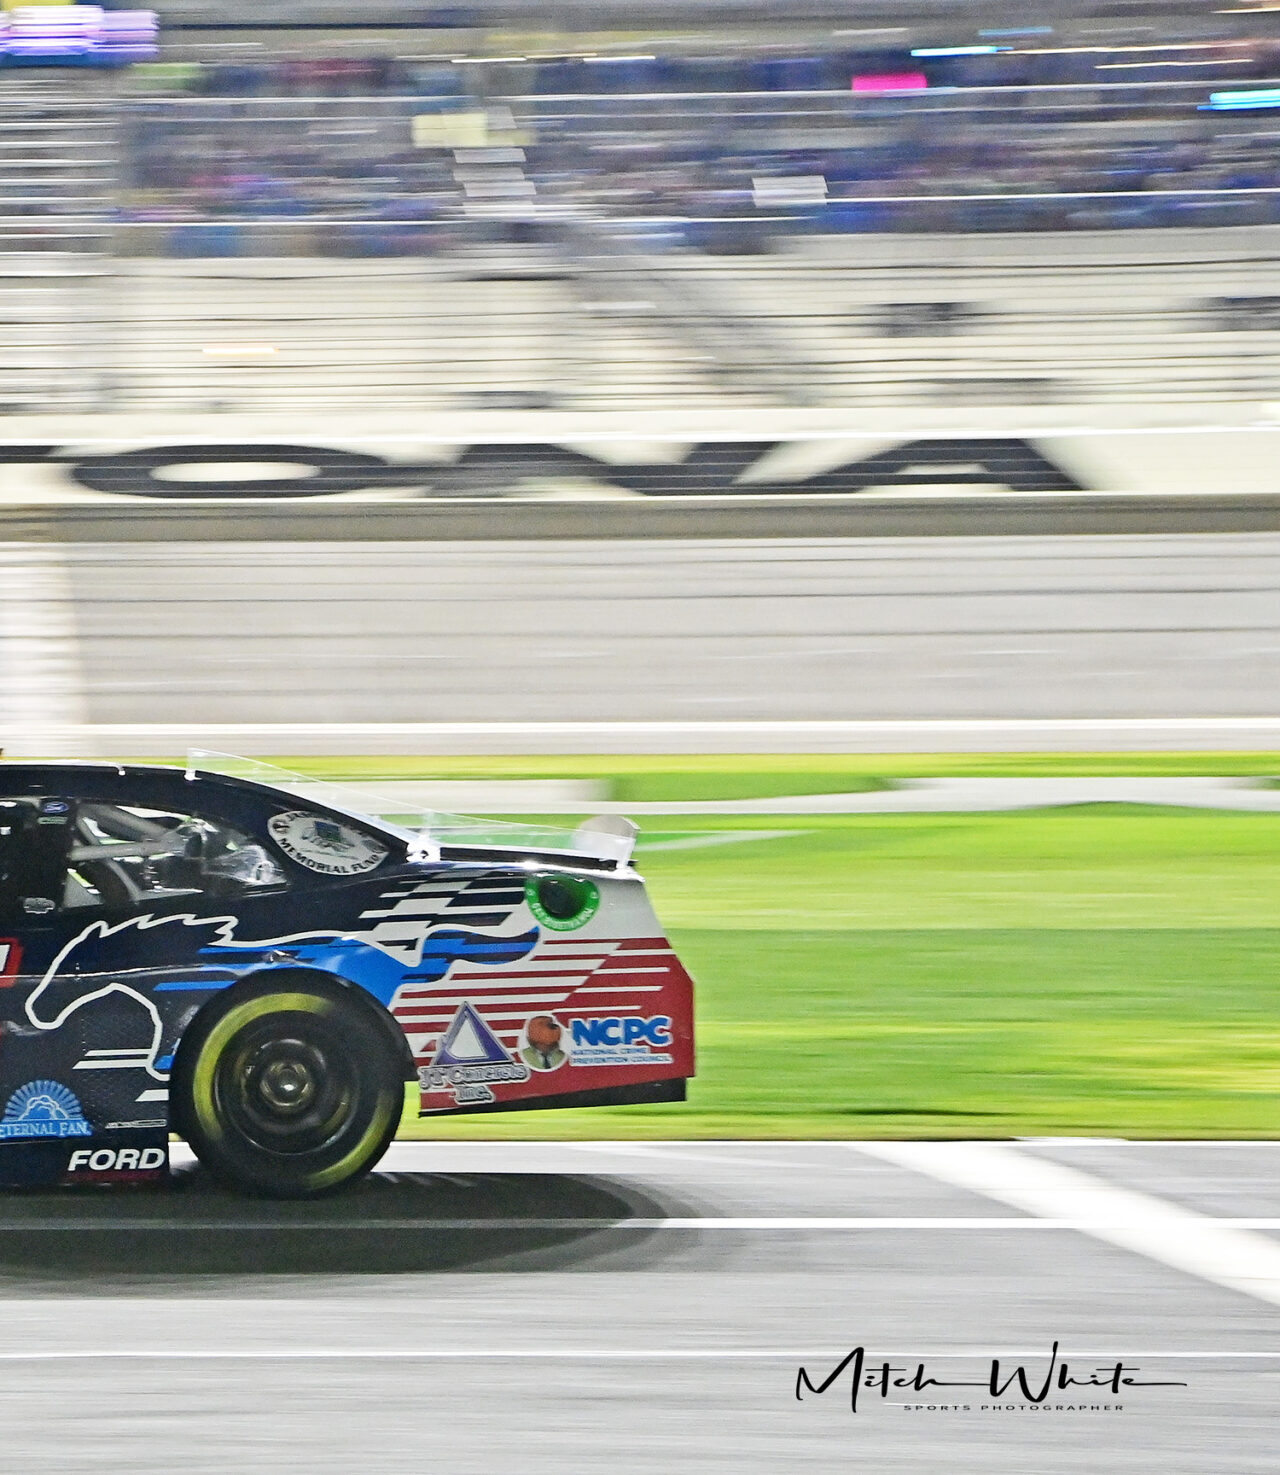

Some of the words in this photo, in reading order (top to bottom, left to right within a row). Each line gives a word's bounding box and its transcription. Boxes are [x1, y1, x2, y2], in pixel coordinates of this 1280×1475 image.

[279, 838, 351, 874] MEMORIAL
[350, 854, 381, 873] FUND
[572, 1017, 670, 1046] NCPC
[67, 1148, 167, 1172] FORD
